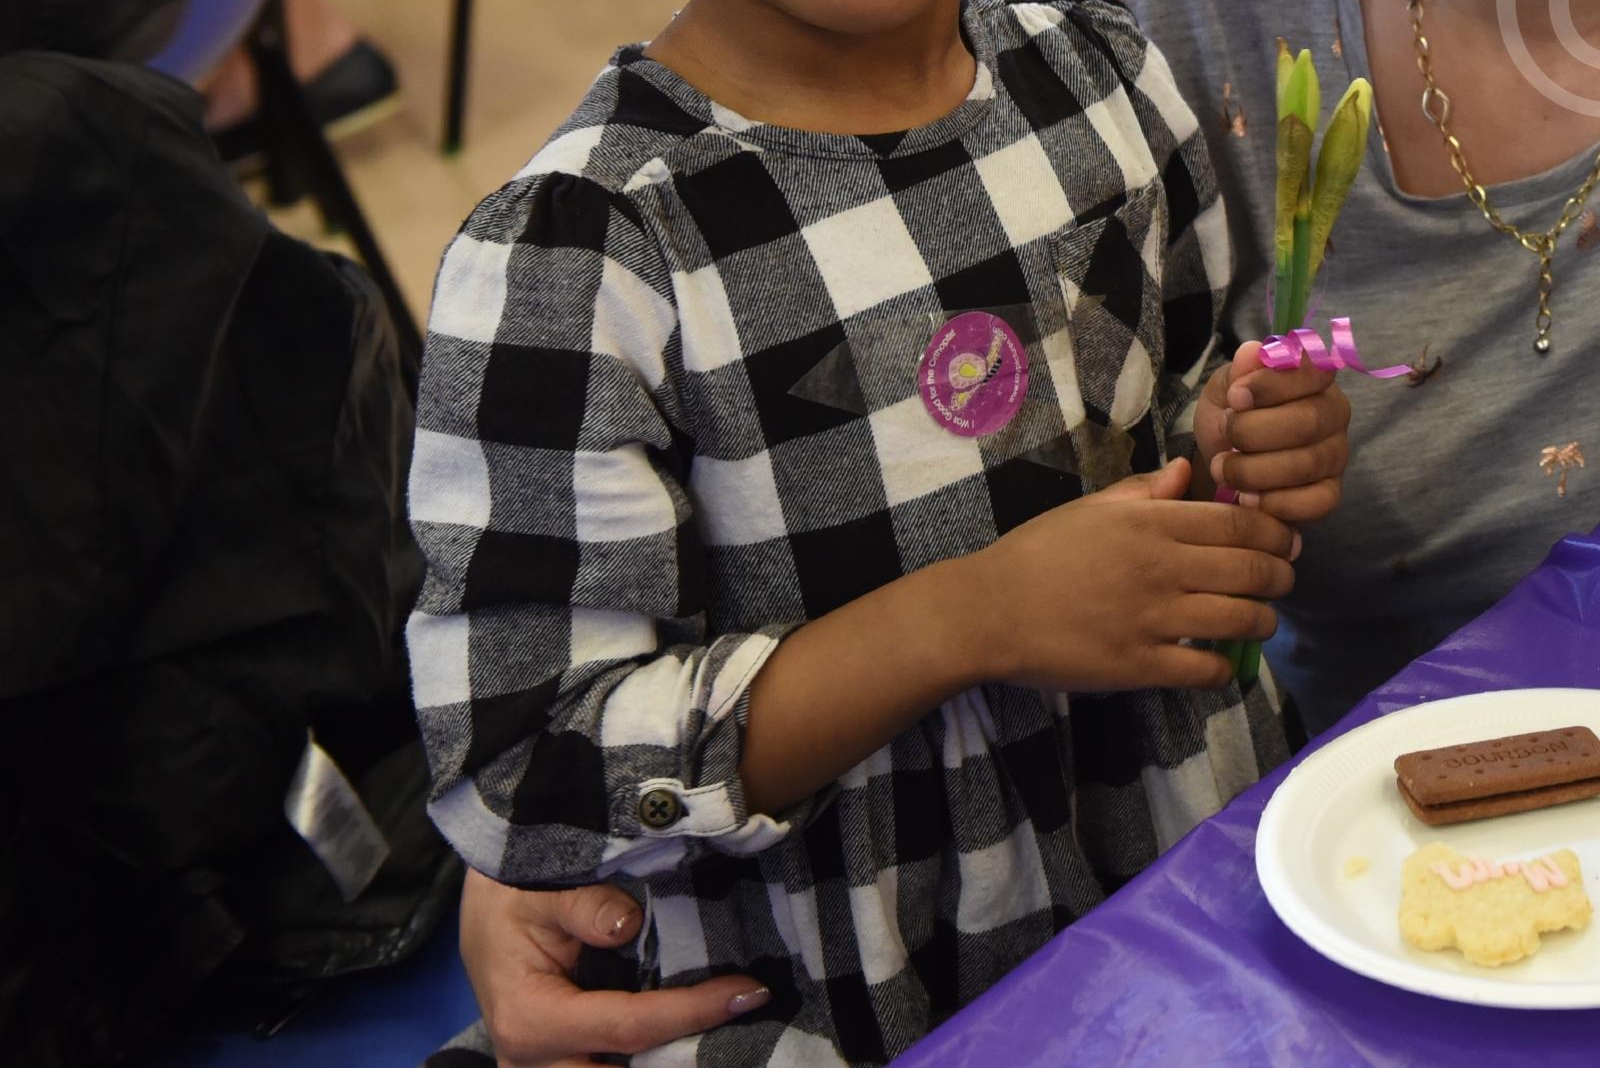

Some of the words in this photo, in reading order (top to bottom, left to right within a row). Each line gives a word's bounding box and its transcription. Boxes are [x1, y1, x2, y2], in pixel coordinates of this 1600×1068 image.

[927, 369, 936, 385] the
[929, 386, 938, 400] for
[933, 398, 953, 421] Good
[953, 416, 970, 429] Was
